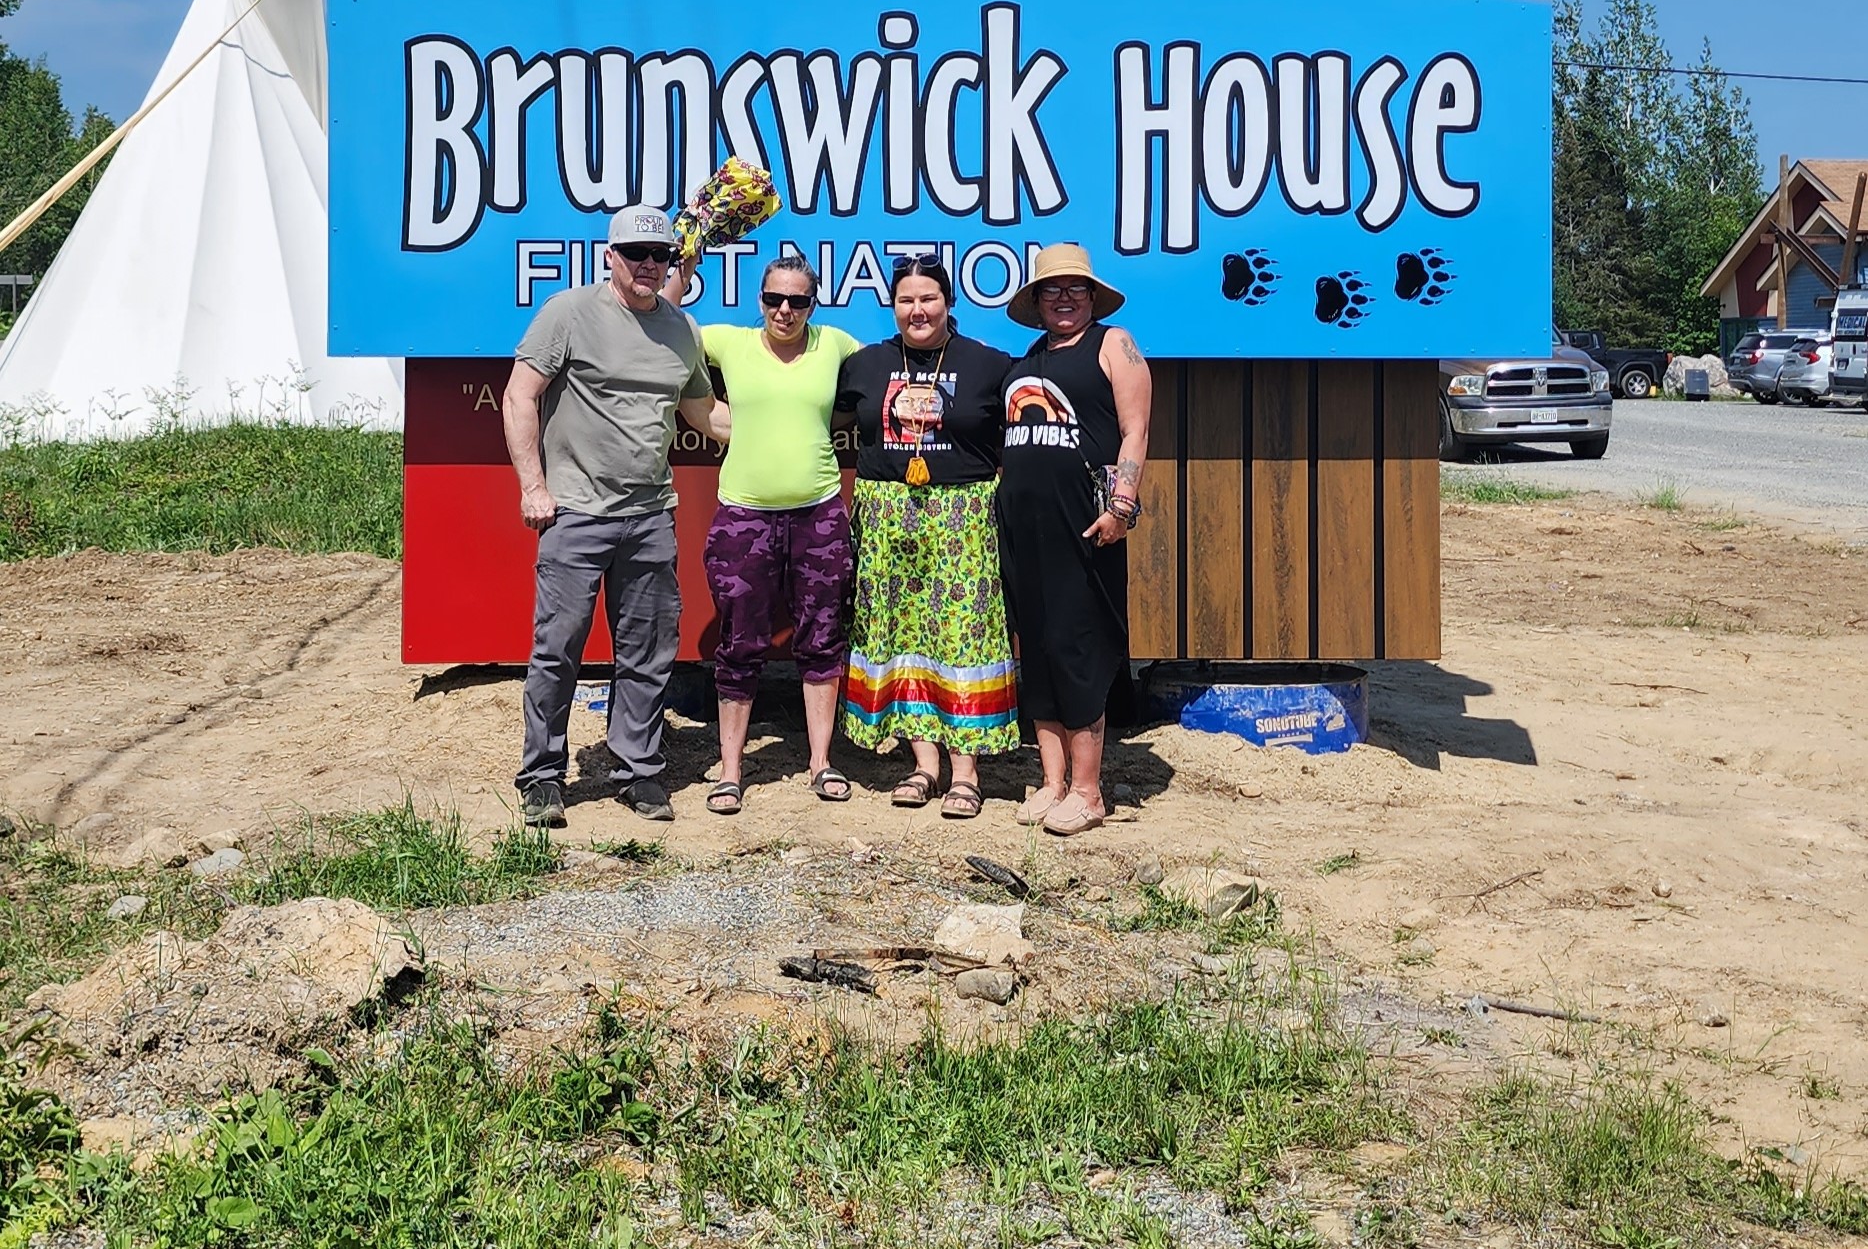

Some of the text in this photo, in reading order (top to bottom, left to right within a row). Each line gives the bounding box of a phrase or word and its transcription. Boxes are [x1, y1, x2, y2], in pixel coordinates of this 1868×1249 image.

[404, 1, 1482, 256] Brunswick House
[890, 371, 957, 381] NO MORE
[1032, 425, 1080, 449] VIBES
